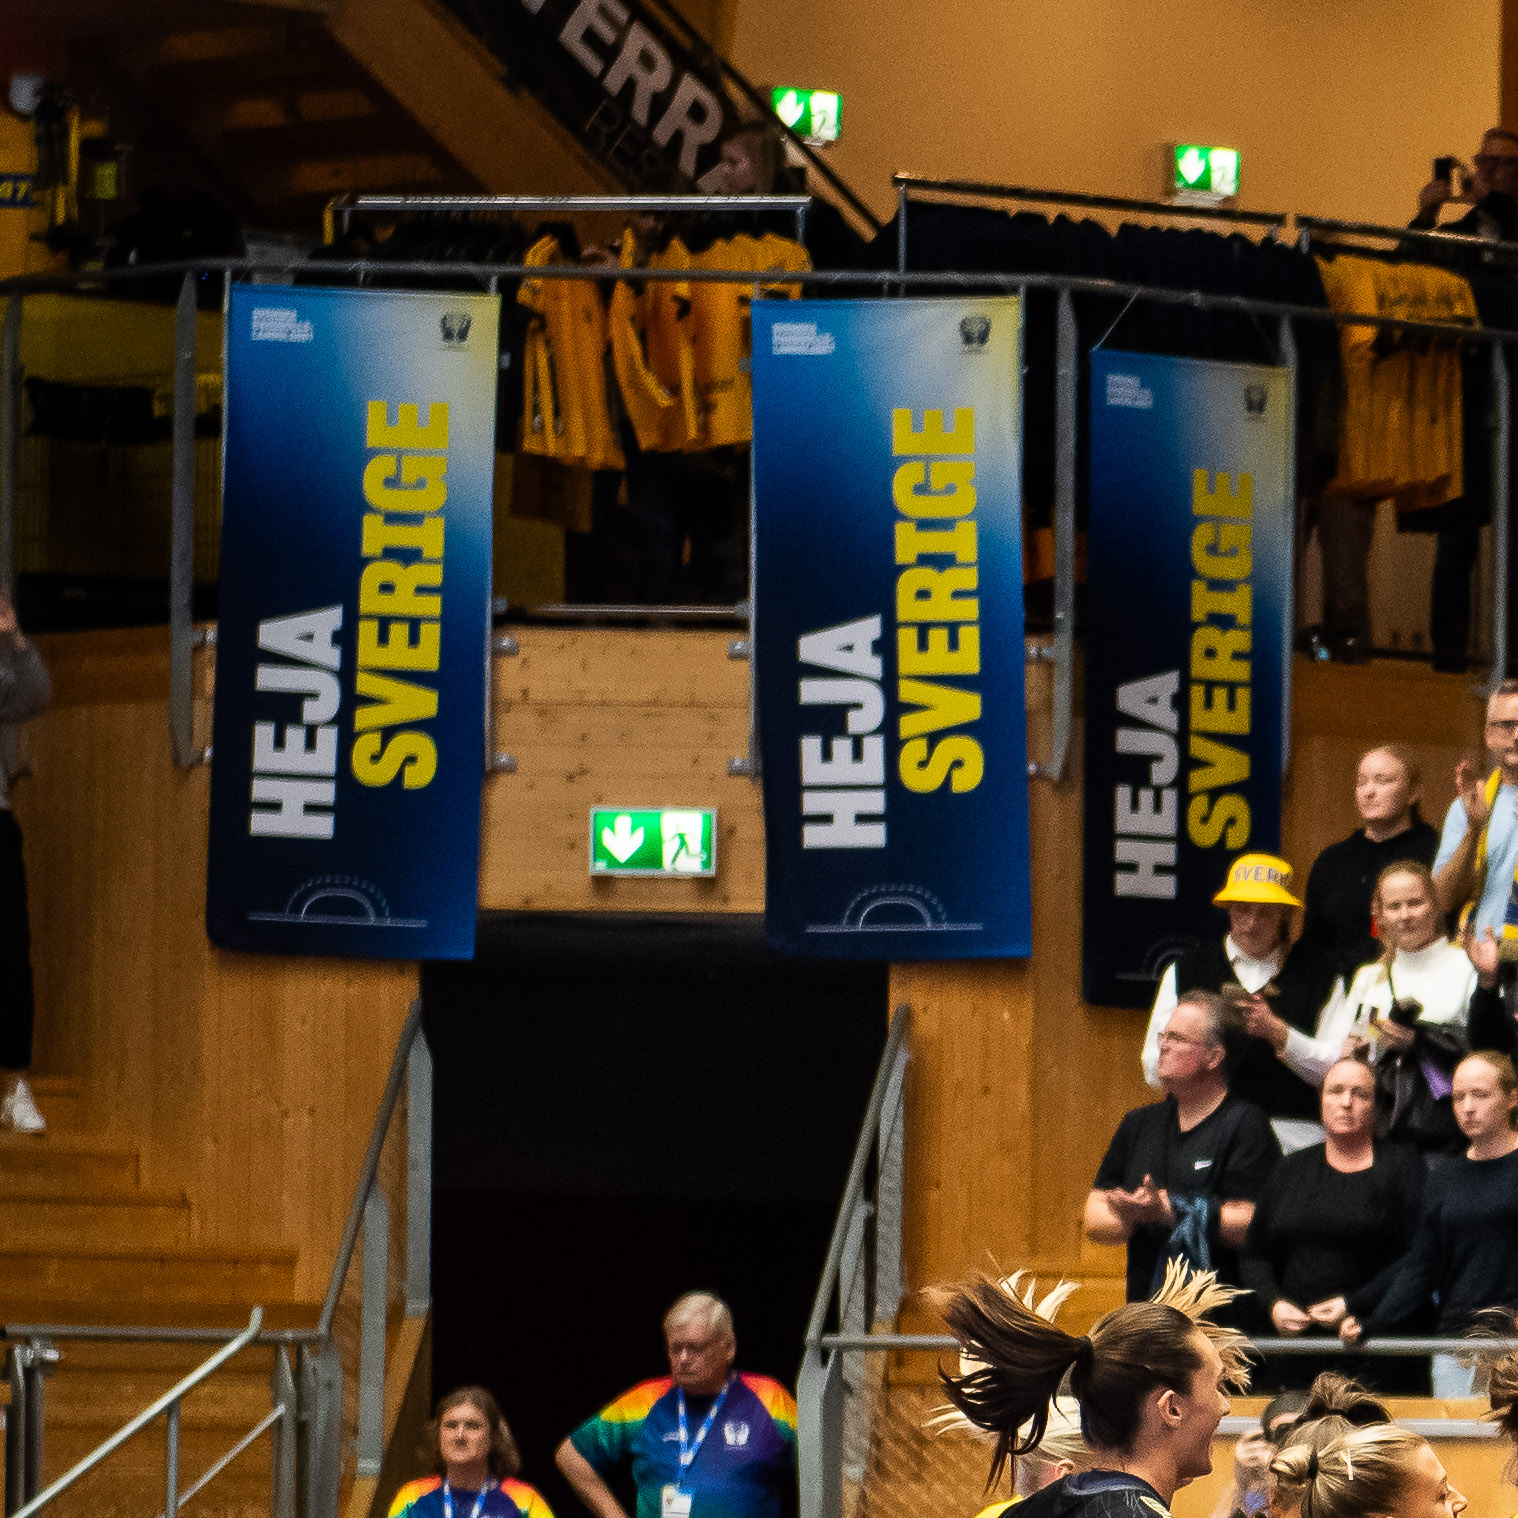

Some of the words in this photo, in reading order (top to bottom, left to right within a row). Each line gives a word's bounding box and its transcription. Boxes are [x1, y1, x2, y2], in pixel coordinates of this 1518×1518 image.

[521, 0, 735, 193] ERR
[353, 403, 448, 786] SVERIGE
[895, 410, 981, 790] SVERIGE
[1187, 468, 1253, 850] SVERIGE
[251, 609, 340, 836] HEJA
[800, 616, 884, 848] HEJA
[1114, 669, 1181, 899] HEJA
